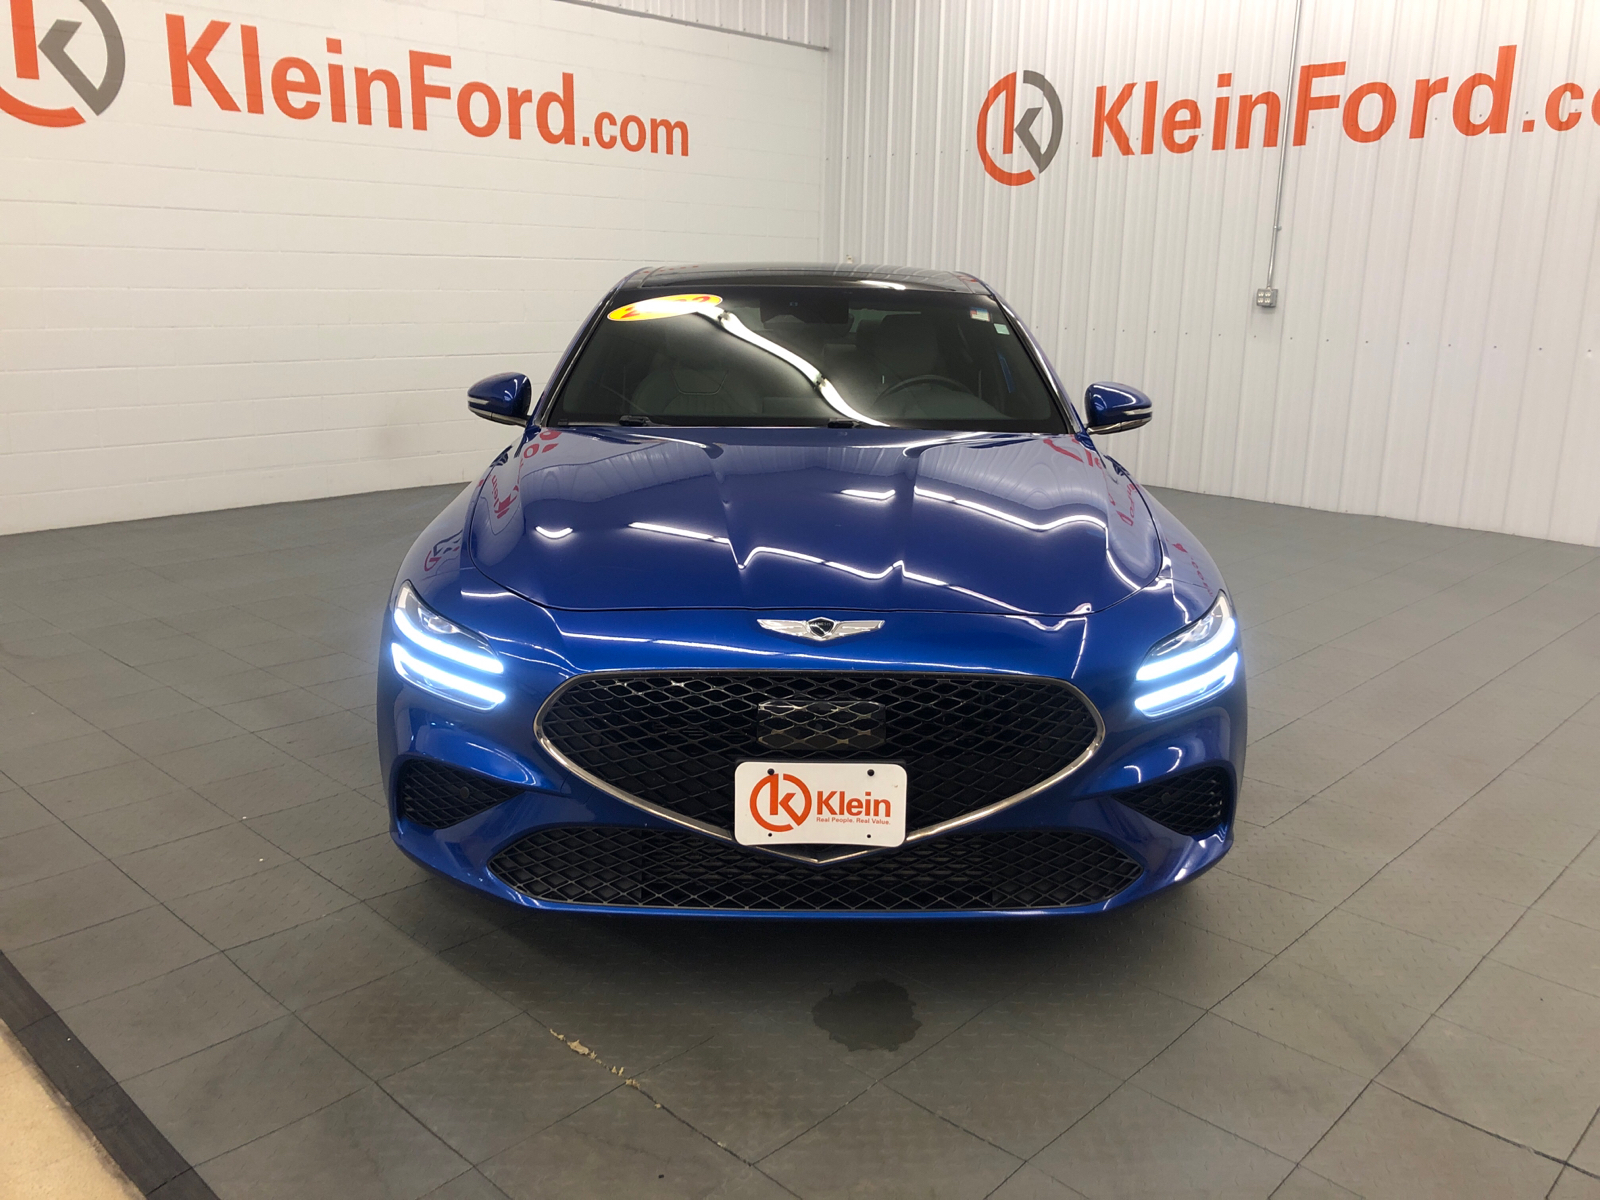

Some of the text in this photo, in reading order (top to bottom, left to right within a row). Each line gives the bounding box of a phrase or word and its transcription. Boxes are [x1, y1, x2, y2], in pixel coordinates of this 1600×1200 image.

[165, 14, 690, 157] KleinFord.com
[1092, 45, 1600, 157] KleinFord.c
[817, 791, 891, 817] Klein
